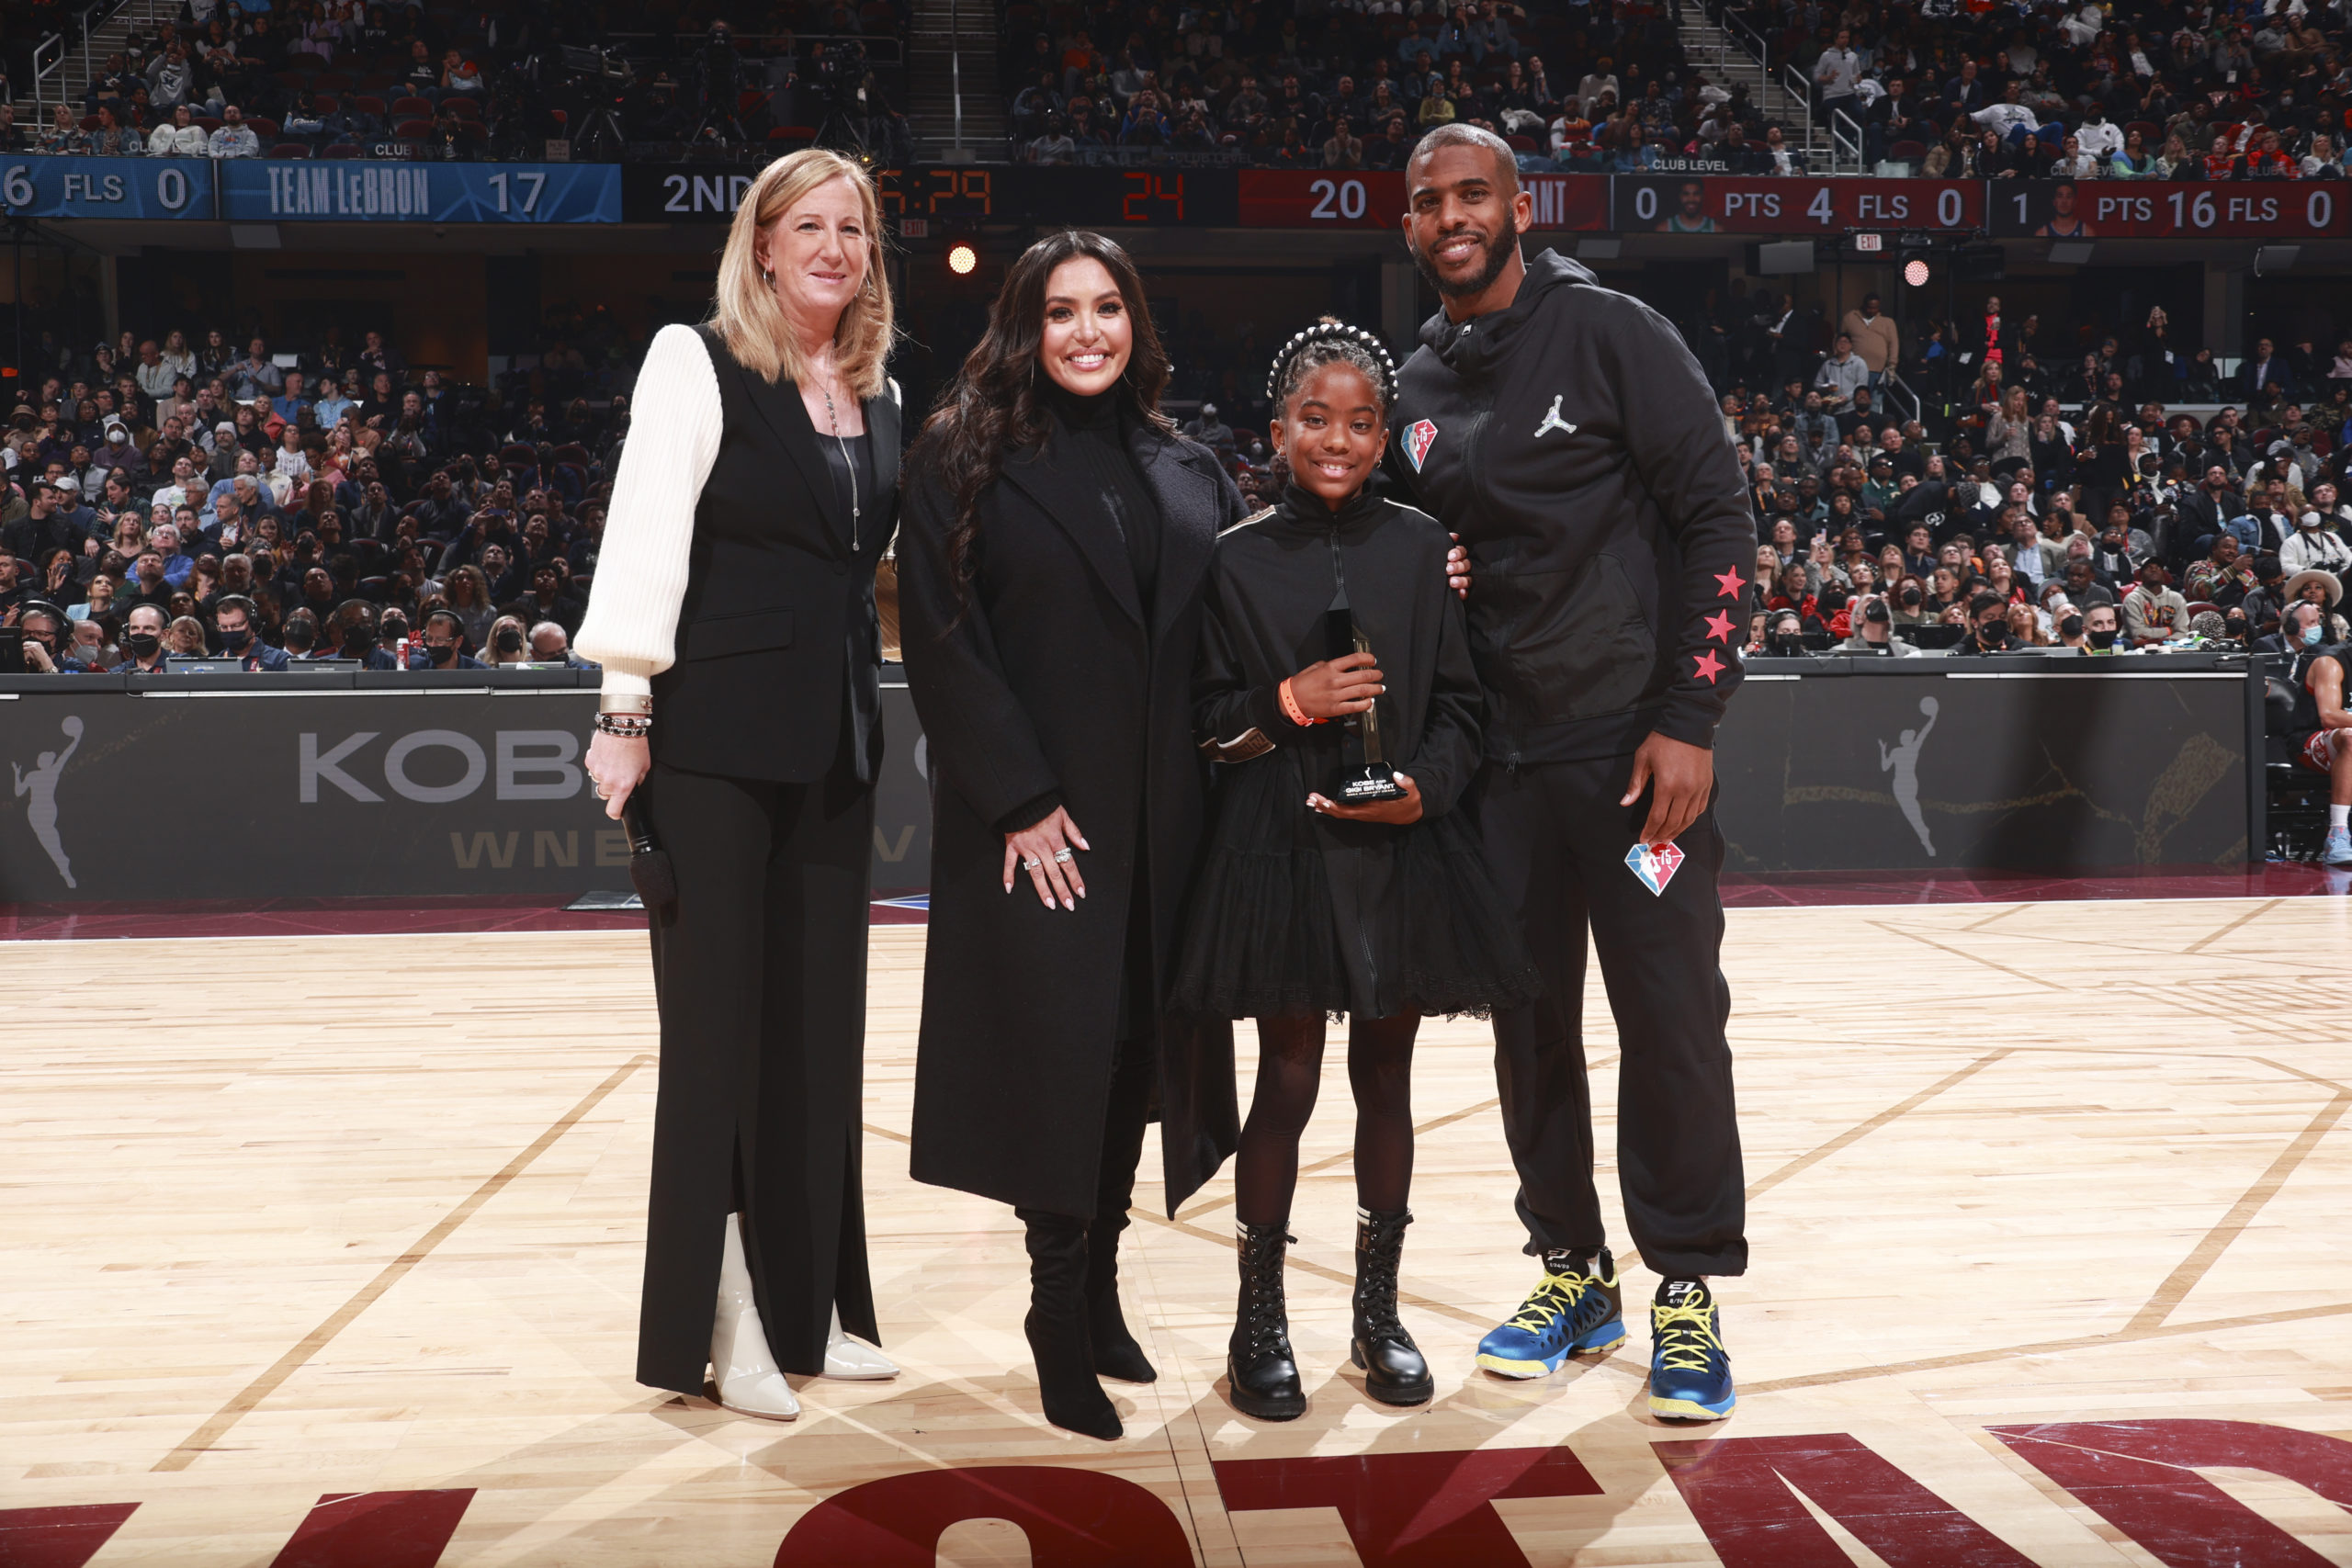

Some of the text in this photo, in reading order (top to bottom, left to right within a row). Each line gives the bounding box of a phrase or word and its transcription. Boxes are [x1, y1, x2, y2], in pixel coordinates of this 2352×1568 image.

[129, 141, 158, 152] CLU
[375, 144, 412, 156] CLUB
[1653, 159, 1729, 172] CLUB LEVEL
[63, 174, 124, 201] FLS
[157, 168, 187, 210] 0
[267, 166, 331, 214] TEAM
[488, 172, 547, 213] 17
[1122, 172, 1184, 220] 24
[1309, 178, 1366, 220] 20
[1635, 186, 1962, 227] 0 PTS 4 FLS 0
[2013, 190, 2332, 229] 1 PTS 16 FLS 0
[905, 220, 925, 235] EXIT
[1860, 235, 1879, 249] EXIT
[299, 728, 599, 804] KOB
[1363, 783, 1396, 792] BRYANT
[1659, 849, 1673, 865] 75
